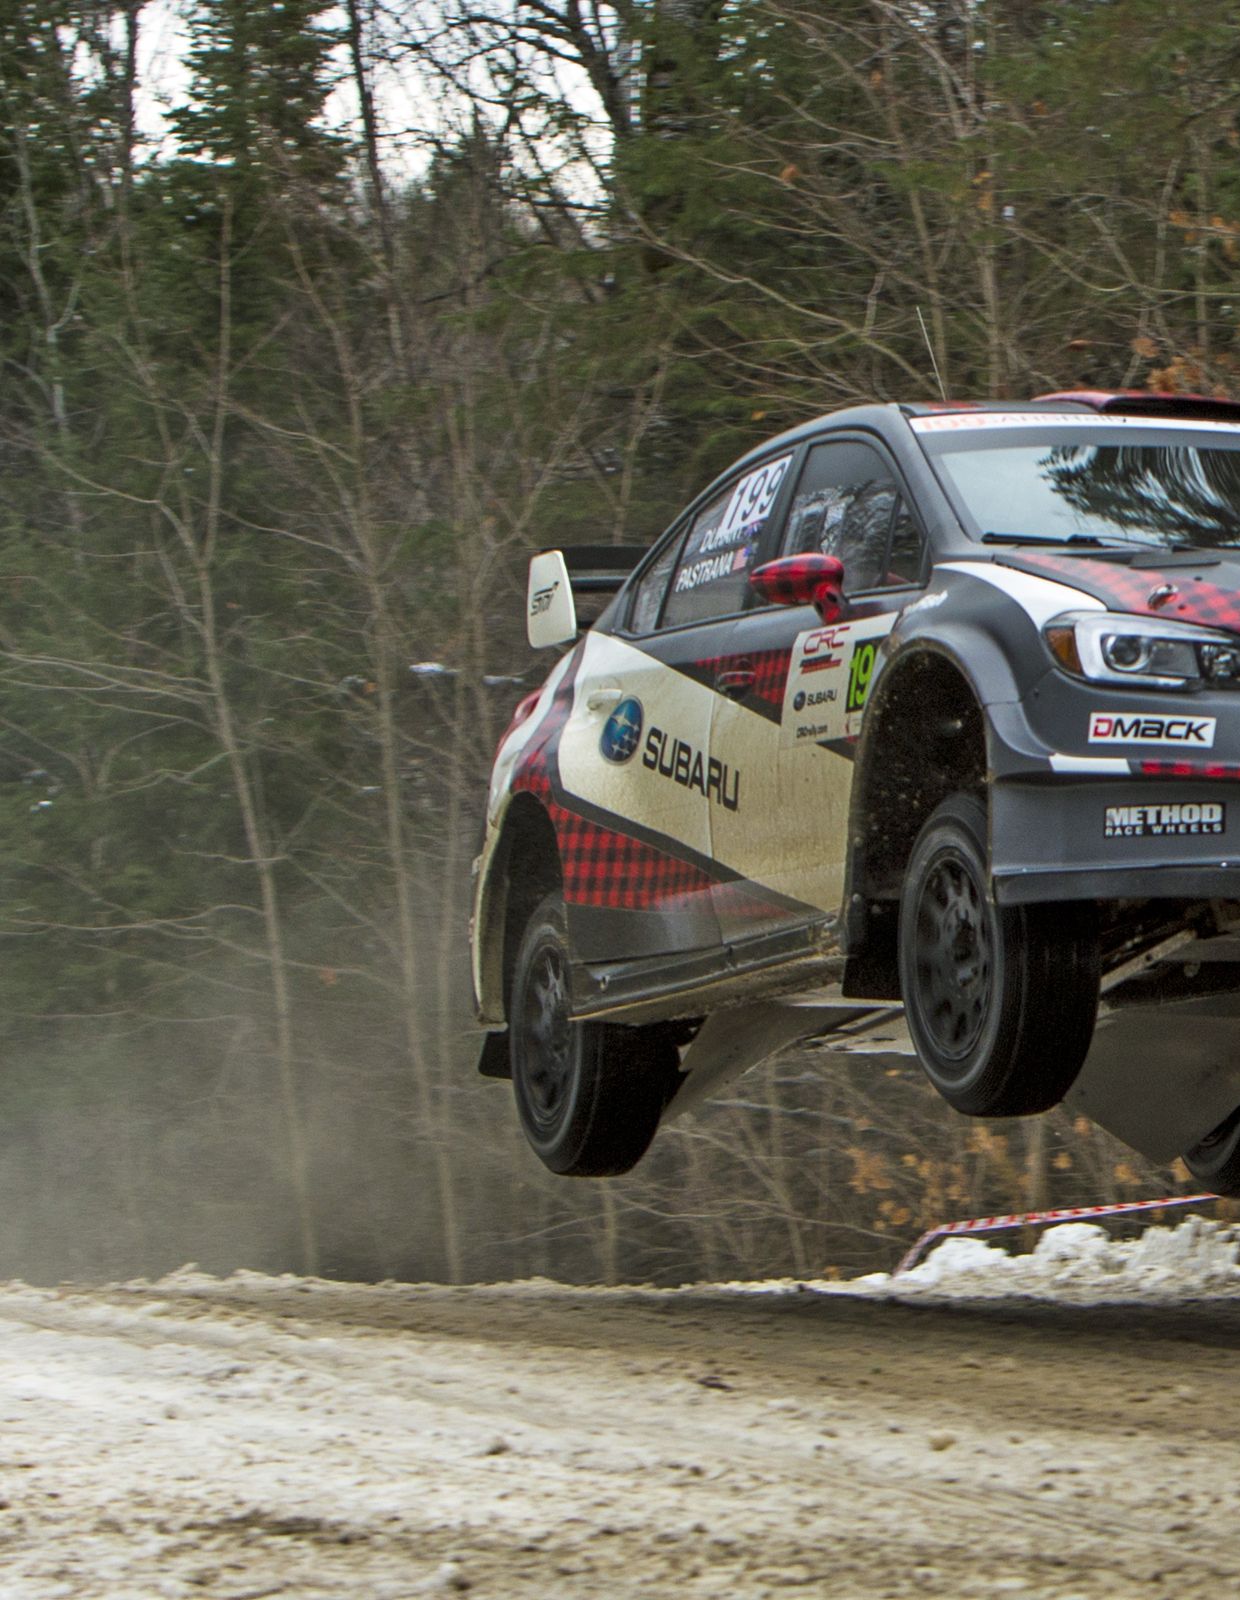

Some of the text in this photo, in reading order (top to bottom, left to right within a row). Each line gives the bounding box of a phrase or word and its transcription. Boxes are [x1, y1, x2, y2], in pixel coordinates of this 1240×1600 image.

[727, 461, 786, 530] 199
[675, 551, 734, 592] PASTRANA
[804, 626, 850, 655] CRC
[807, 689, 837, 706] SUBARU
[642, 727, 739, 811] SUBARU
[1105, 804, 1222, 827] METHOD
[1105, 823, 1222, 837] RACE WHEELS
